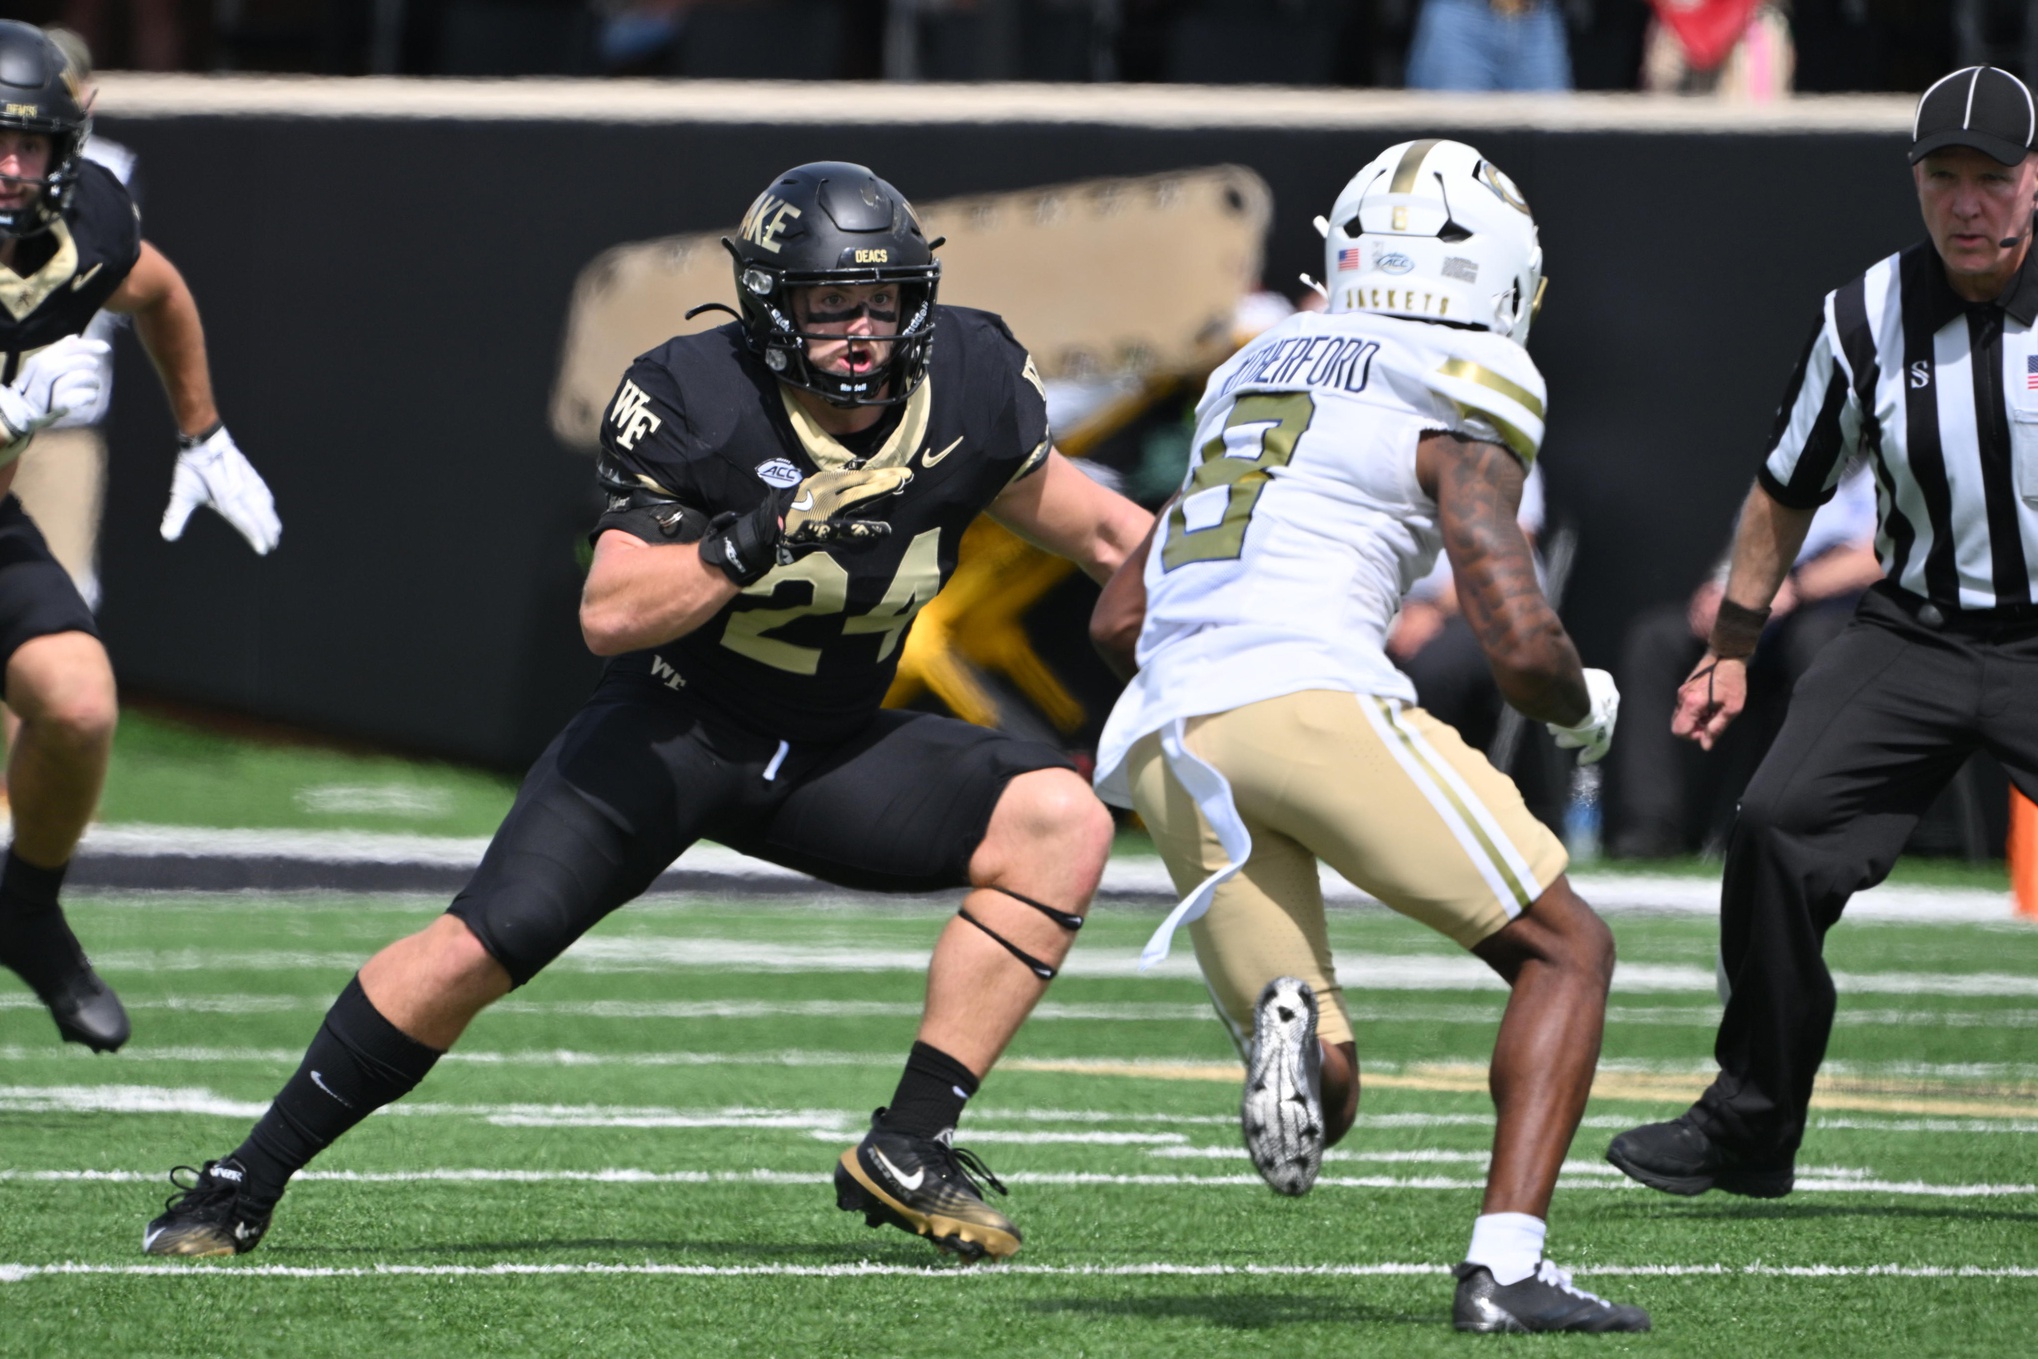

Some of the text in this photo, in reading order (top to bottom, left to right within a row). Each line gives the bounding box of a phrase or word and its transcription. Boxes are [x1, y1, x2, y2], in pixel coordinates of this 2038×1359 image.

[736, 190, 802, 254] AKE
[855, 249, 888, 263] DEACS
[1346, 287, 1450, 316] JACKETS
[610, 378, 662, 451] WF
[1161, 391, 1316, 575] 8
[720, 526, 942, 676] 24
